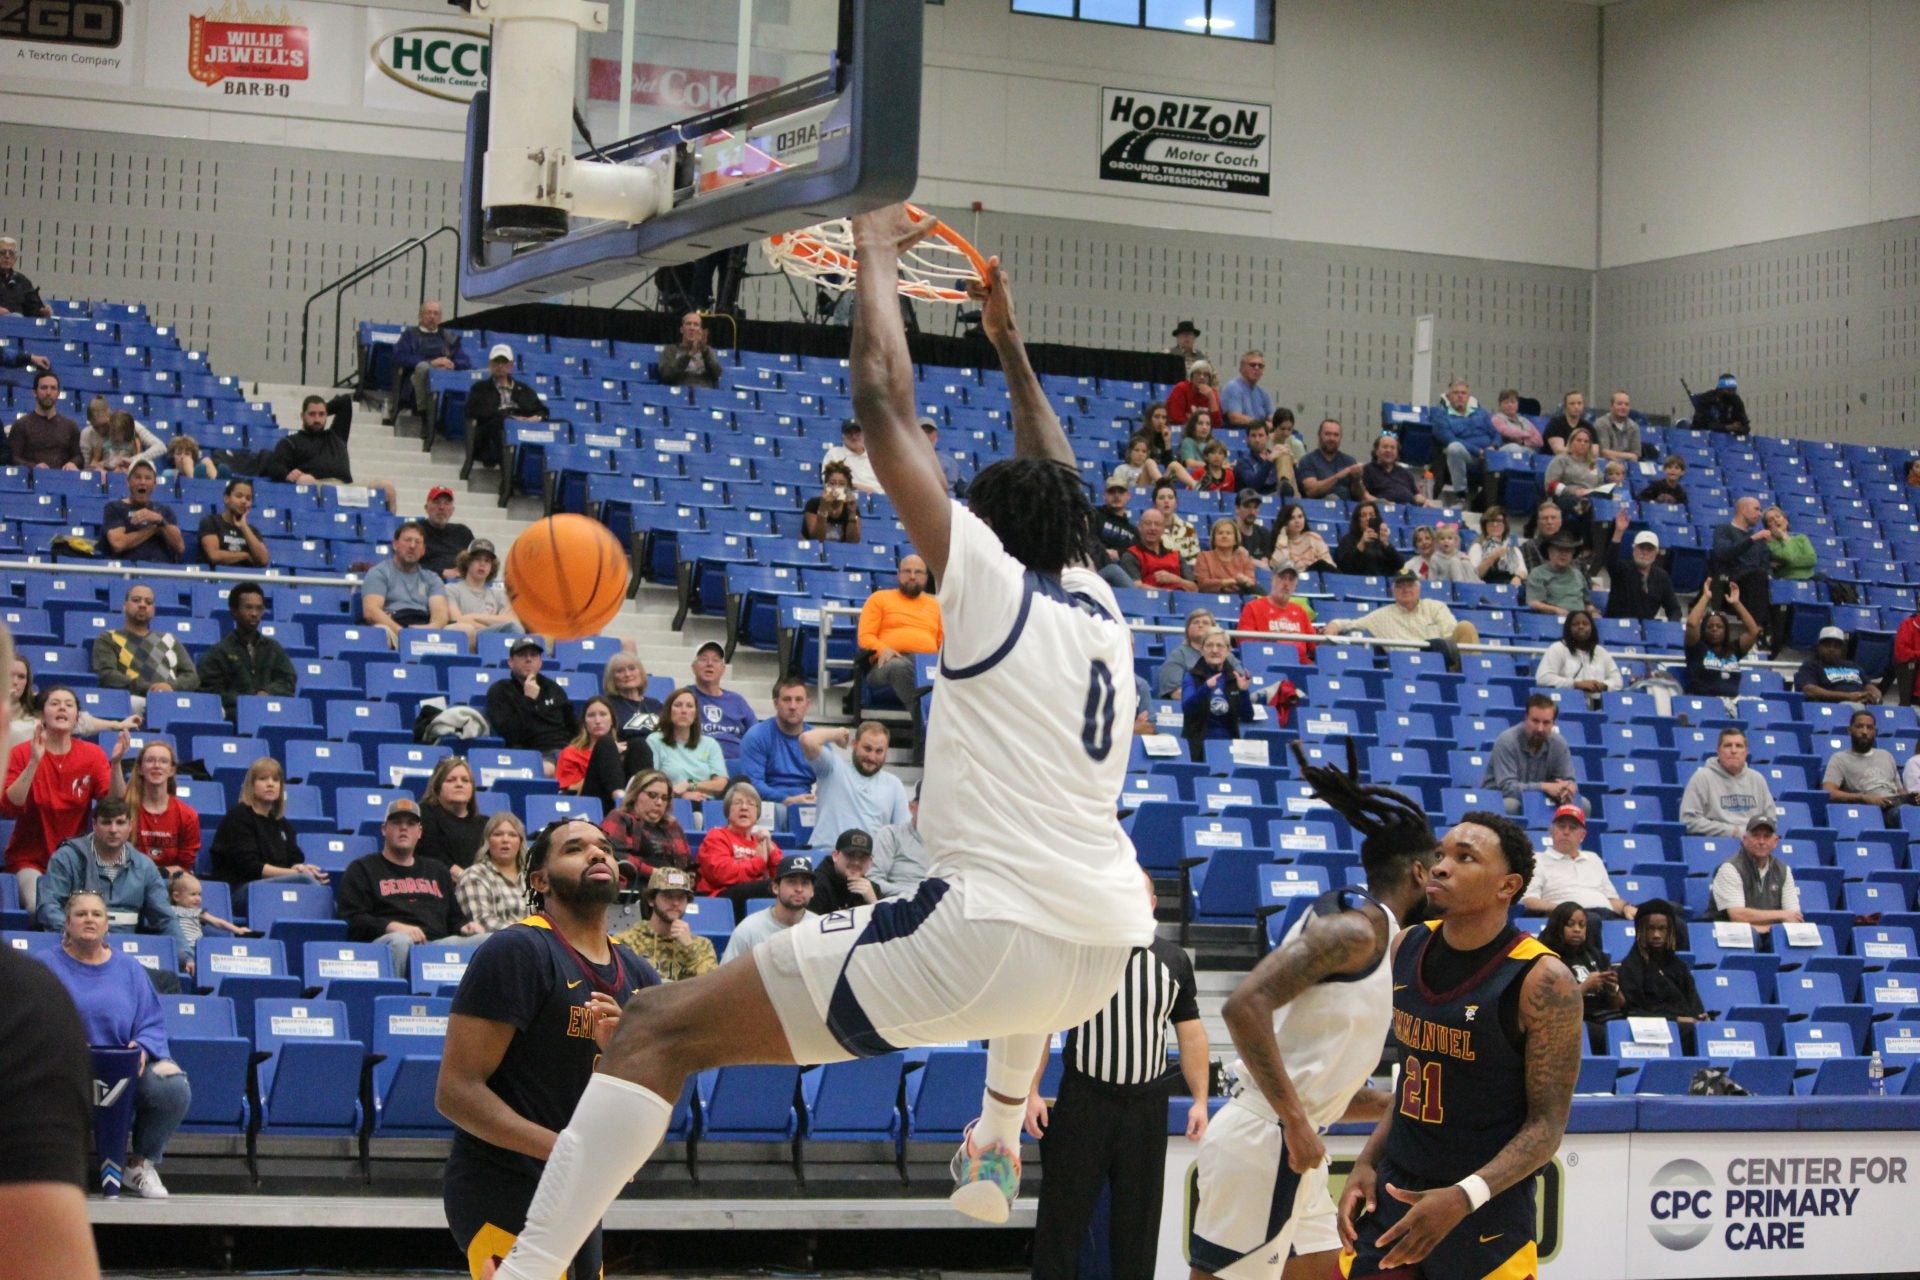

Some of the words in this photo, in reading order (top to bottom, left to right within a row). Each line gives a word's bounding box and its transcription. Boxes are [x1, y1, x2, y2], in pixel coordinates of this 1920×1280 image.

[226, 31, 284, 48] WILLIE
[17, 49, 25, 58] A
[28, 50, 68, 62] Textron
[71, 53, 121, 69] Company
[204, 45, 305, 67] JEWELL'S
[224, 81, 290, 98] BAR-B-Q
[416, 74, 446, 85] Health
[448, 77, 478, 88] Center
[1110, 96, 1258, 140] HORIZON
[1165, 146, 1210, 163] Motor
[1214, 151, 1259, 168] Coach
[1109, 160, 1160, 173] GROUND
[1162, 165, 1260, 184] TRANSPORTATION
[1140, 172, 1229, 190] PROFESSIONALS
[1081, 657, 1116, 763] 0
[379, 877, 444, 898] GEORGIA
[1392, 1007, 1476, 1061] MMANUEL
[1400, 1055, 1444, 1124] 21
[1727, 1158, 1842, 1185] CENTER
[1849, 1157, 1907, 1184] FOR
[1650, 1190, 1713, 1220] CPC
[1725, 1188, 1861, 1218] PRIMARY
[1724, 1222, 1805, 1251] CARE
